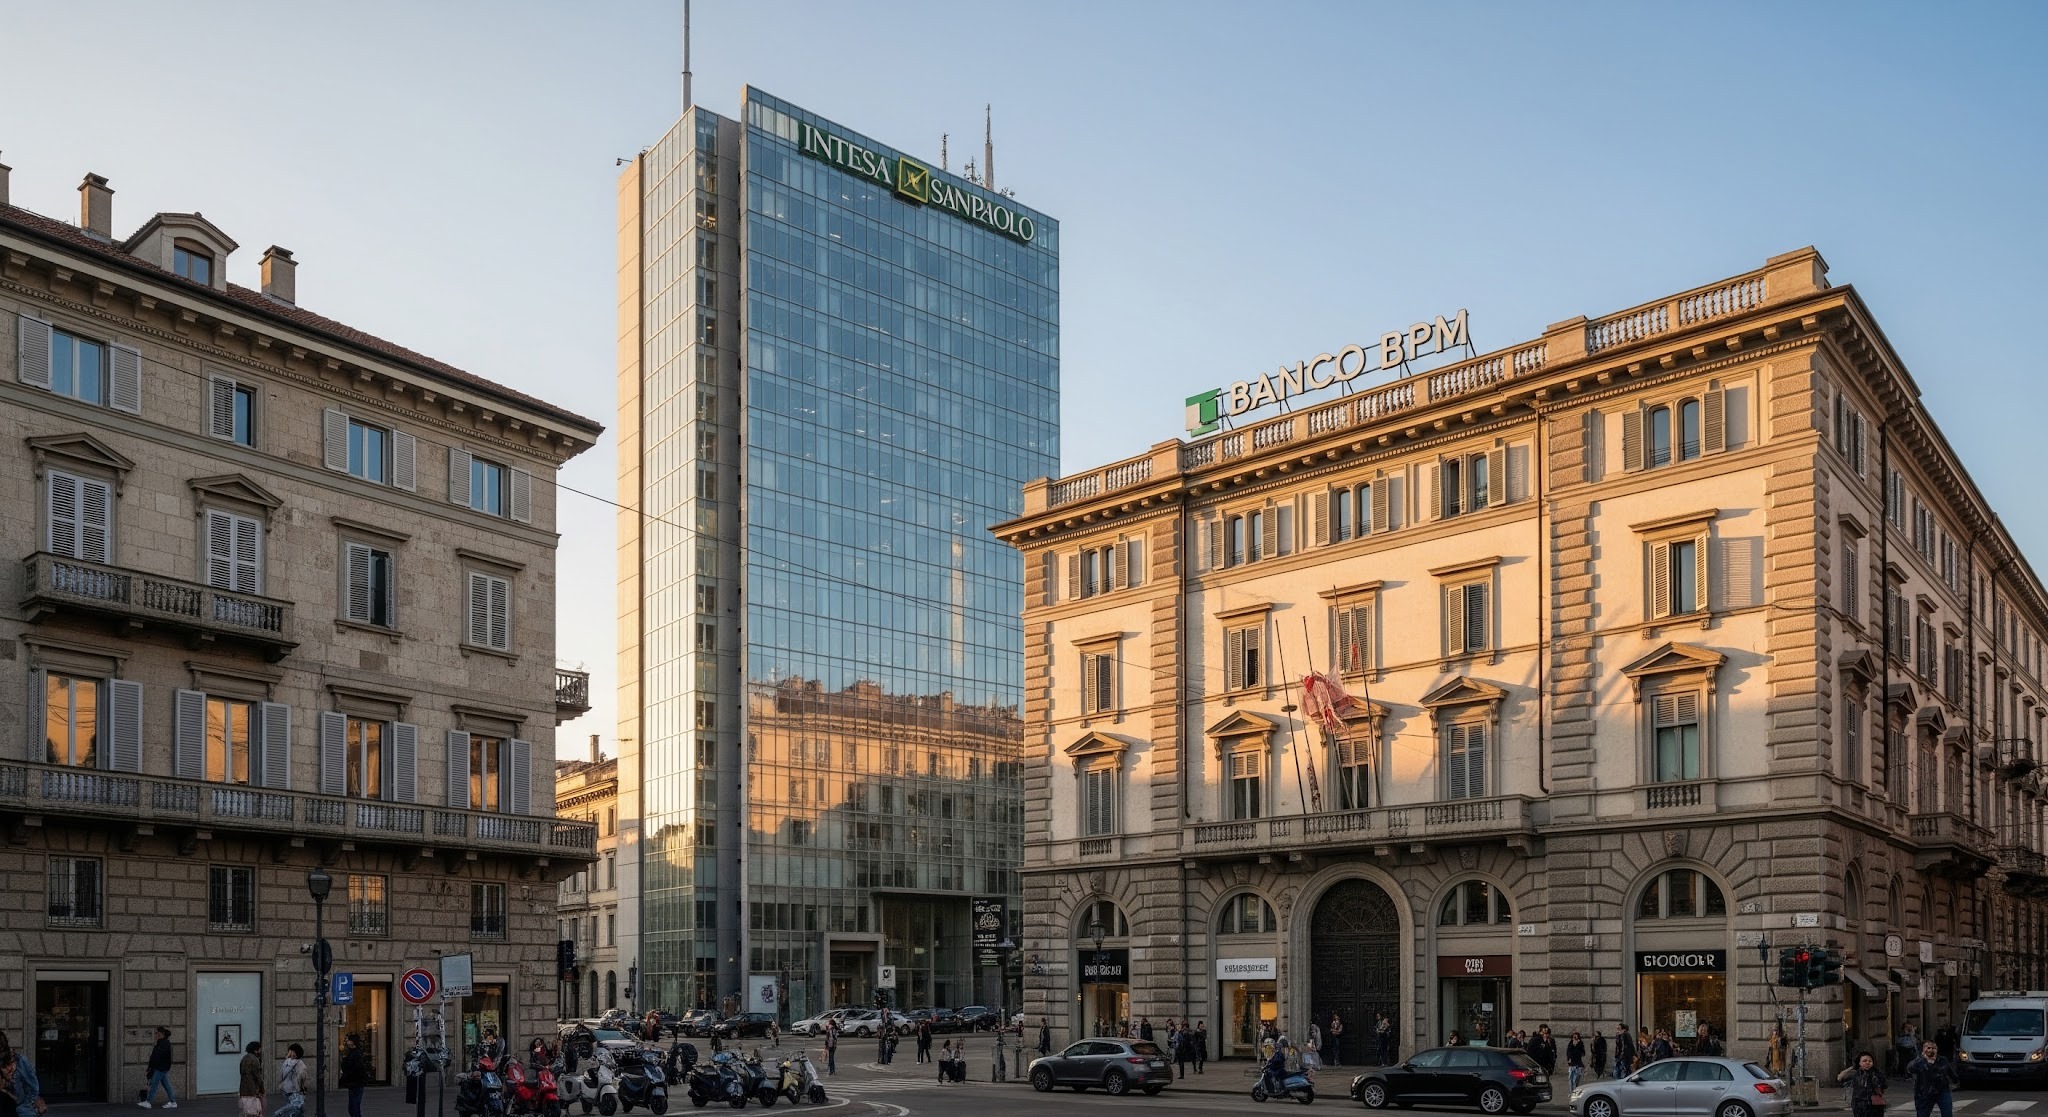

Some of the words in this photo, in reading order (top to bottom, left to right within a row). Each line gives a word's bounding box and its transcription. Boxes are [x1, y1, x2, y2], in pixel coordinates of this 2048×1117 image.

[803, 123, 892, 184] INTESA
[930, 178, 1035, 241] SANPAOLO
[1229, 344, 1366, 416] BANCO
[1381, 308, 1468, 370] BPM
[338, 976, 348, 991] P
